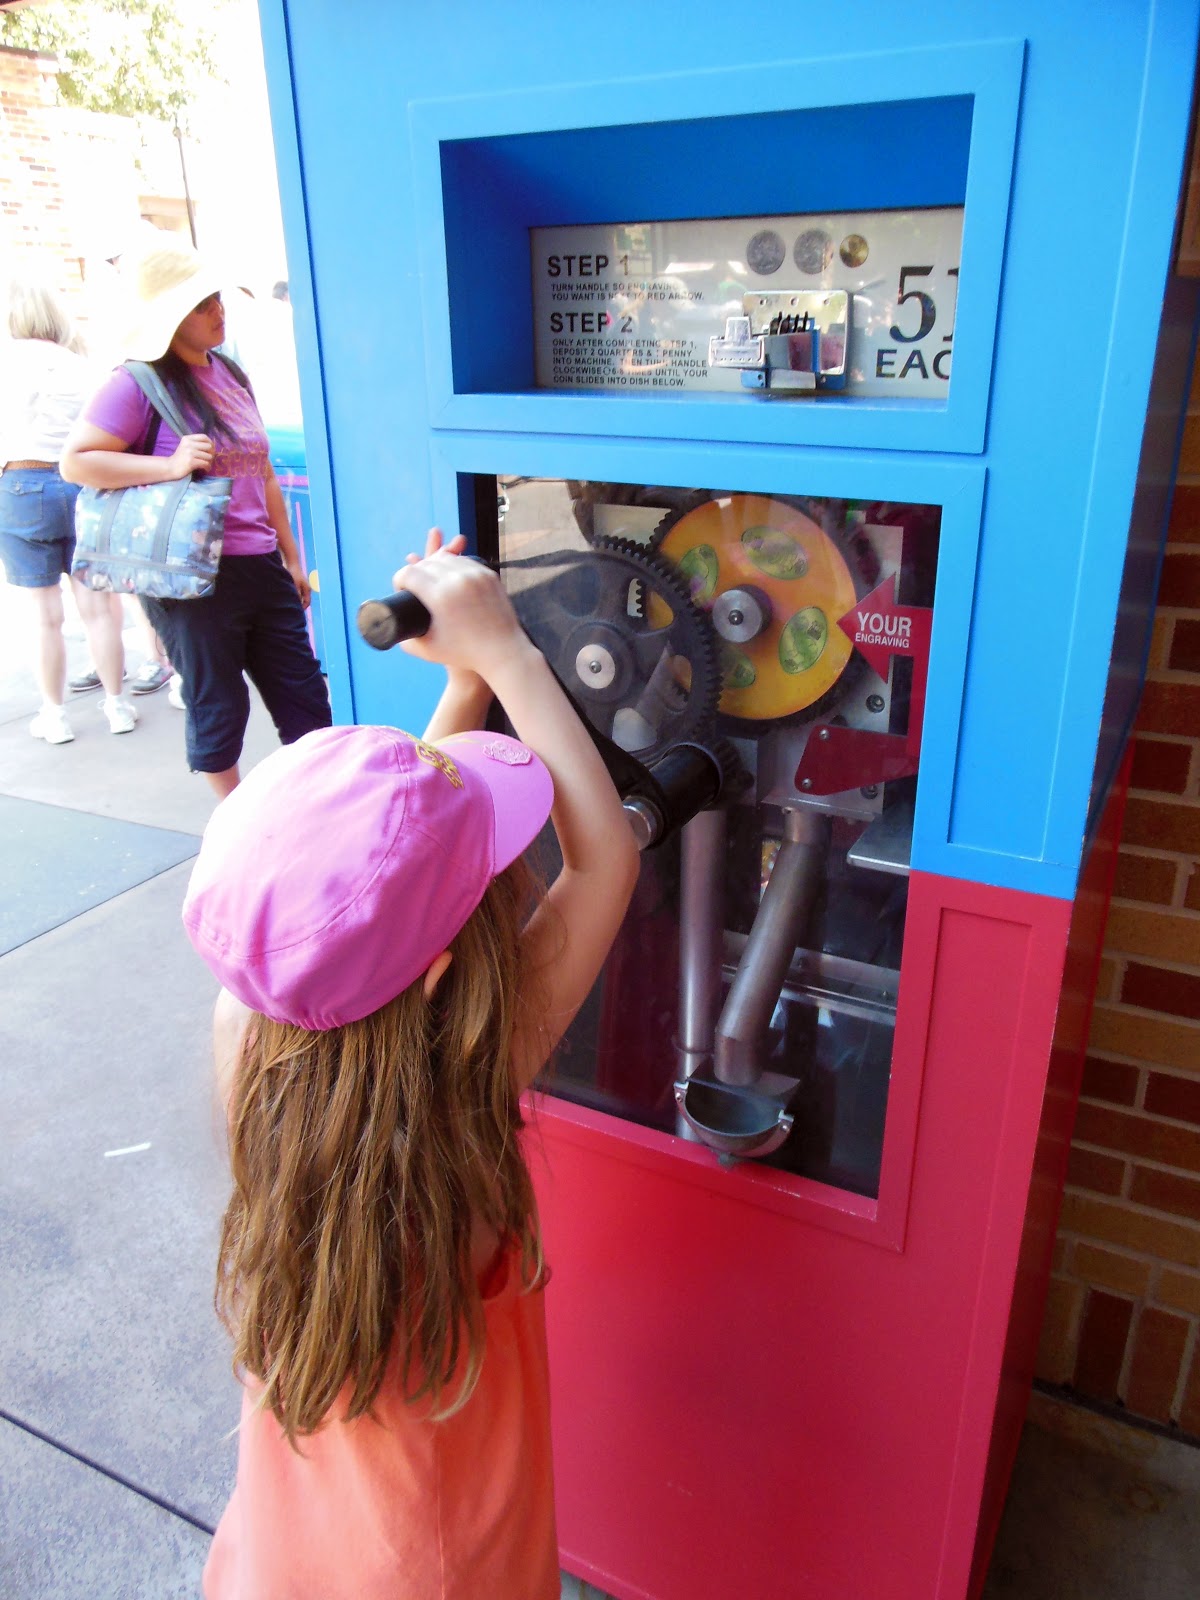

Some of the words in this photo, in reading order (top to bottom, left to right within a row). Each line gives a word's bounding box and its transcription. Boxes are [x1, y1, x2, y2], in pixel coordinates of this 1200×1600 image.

[547, 254, 609, 277] STEP
[619, 254, 629, 276] 1
[551, 283, 573, 292] TURN
[576, 283, 609, 292] HANDLE
[613, 283, 624, 292] SO
[552, 292, 569, 301] YOU
[571, 292, 594, 301] WANT
[597, 292, 606, 300] IS
[647, 292, 666, 300] RED
[550, 312, 611, 333] STEP
[620, 315, 633, 333] 2
[552, 338, 574, 347] ONLY
[576, 338, 603, 347] AFTER
[552, 348, 588, 357] DEPOSIT
[590, 348, 595, 357] 2
[662, 349, 693, 358] PENNY
[552, 358, 572, 366] INTO
[574, 358, 615, 366] MACHINE.
[671, 360, 707, 368] HANDLE
[553, 366, 602, 375] CLOCKWISE
[655, 368, 680, 377] UNTIL
[682, 369, 708, 378] YOUR
[553, 375, 573, 384] COIN
[576, 376, 605, 384] SLIDES
[607, 377, 627, 385] INTO
[629, 377, 650, 386] DISH
[652, 378, 686, 388] BELOW.
[858, 612, 912, 637] YOUR
[855, 632, 910, 648] ENGRAVING
